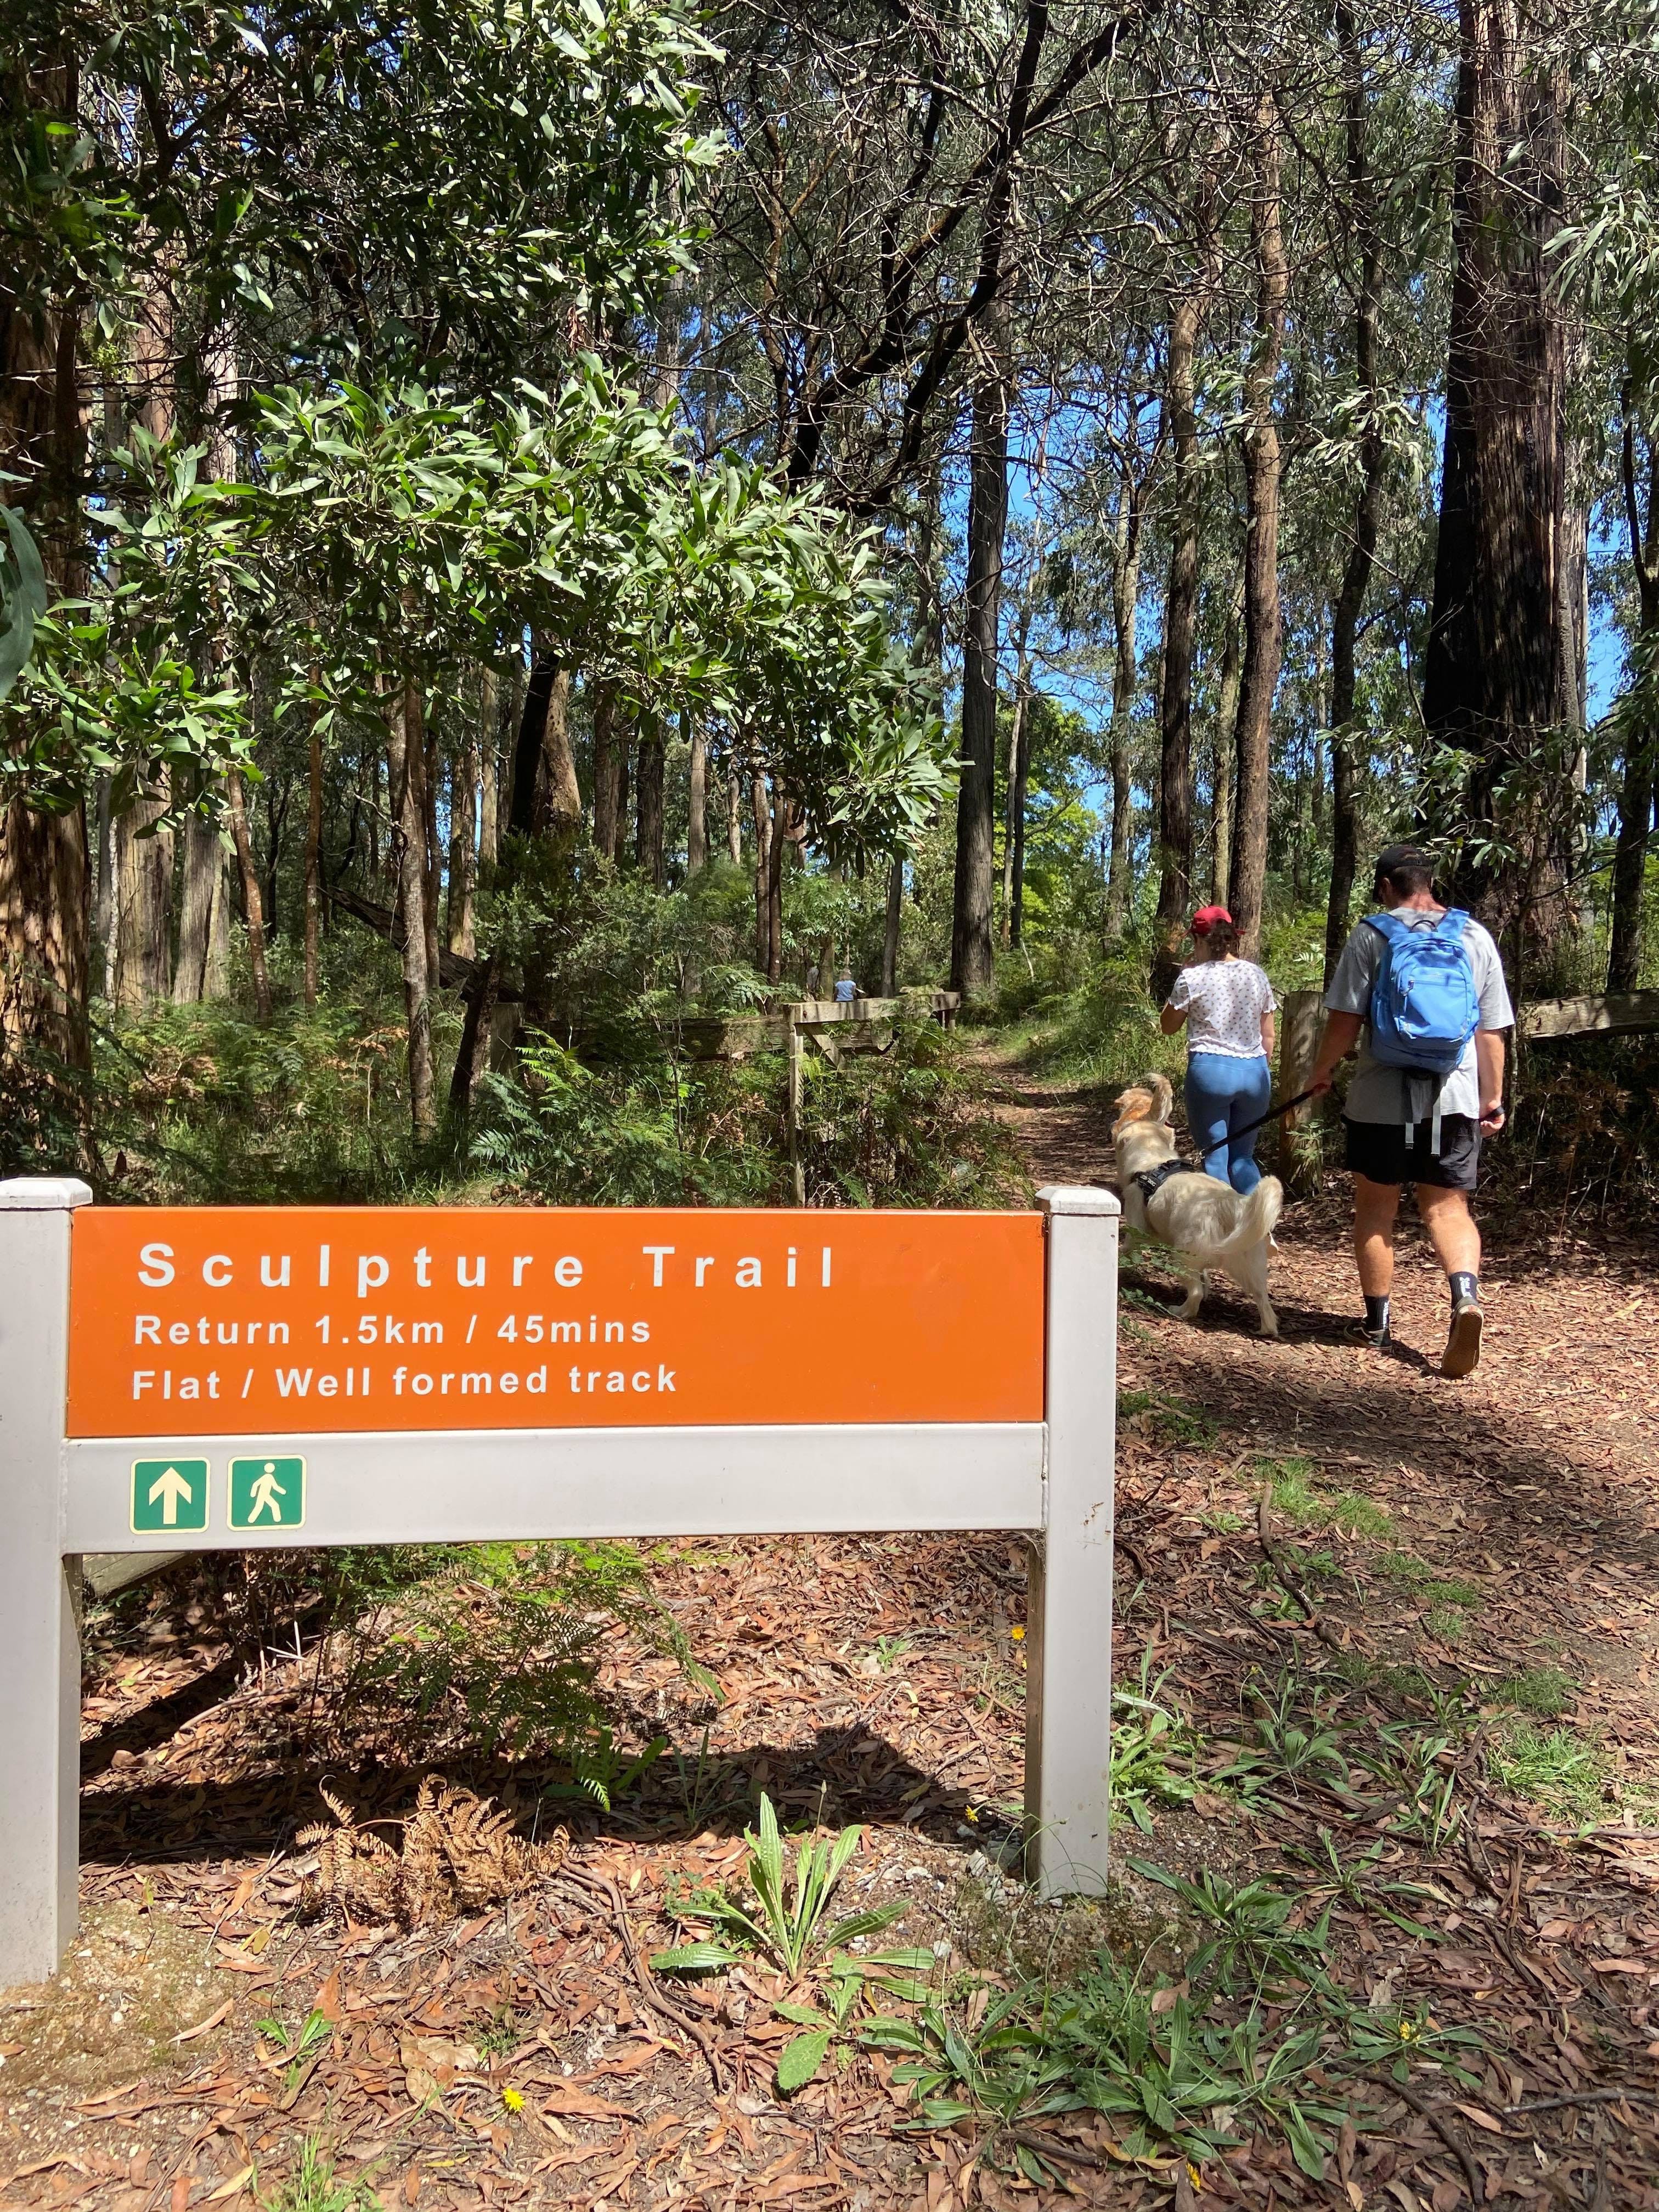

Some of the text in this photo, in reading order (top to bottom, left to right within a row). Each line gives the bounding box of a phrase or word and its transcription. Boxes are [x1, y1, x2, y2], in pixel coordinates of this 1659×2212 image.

[137, 1243, 832, 1299] Sculpture Trail
[134, 1314, 651, 1345] Return 1.5km / 45mins
[132, 1363, 676, 1400] Flat / Well formed track
